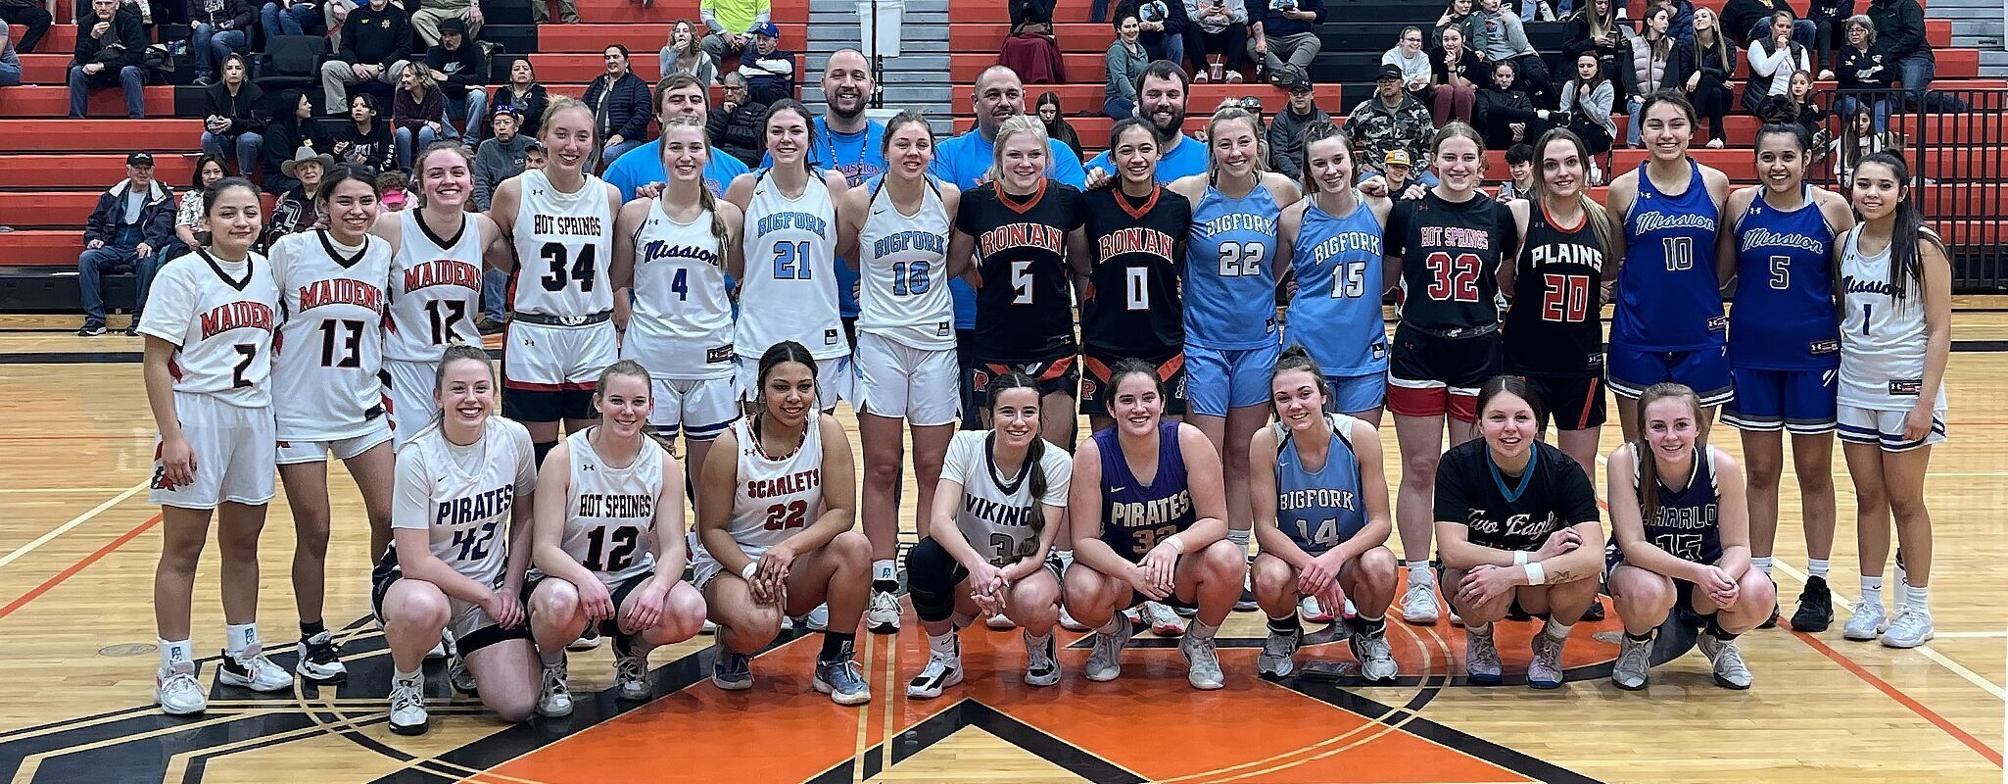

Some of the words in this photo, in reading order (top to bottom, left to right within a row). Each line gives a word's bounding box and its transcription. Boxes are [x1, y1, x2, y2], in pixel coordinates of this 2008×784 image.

[534, 214, 555, 236] HOT
[557, 215, 601, 237] SPRINGS
[757, 212, 827, 241] BIGFORK
[980, 222, 1063, 259] RONAN
[1206, 212, 1274, 239] BIGFORK
[1421, 226, 1443, 247] HOT
[1444, 227, 1489, 250] SPRINGS
[1636, 211, 1715, 236] Mission
[643, 239, 720, 266] Mission
[874, 230, 945, 259] BIGFORK
[1099, 226, 1175, 265] RONAN
[1314, 231, 1381, 265] BIGFORK
[1531, 243, 1603, 273] PLAINS
[1663, 237, 1694, 271] 10
[1741, 228, 1824, 255] Mission
[540, 242, 596, 293] 34
[773, 241, 812, 280] 21
[1218, 241, 1265, 277] 22
[1770, 256, 1791, 290] 5
[404, 259, 483, 296] MAIDENS
[671, 268, 688, 302] 4
[1011, 260, 1035, 305] 5
[1126, 266, 1150, 310] 0
[1331, 261, 1367, 299] 15
[1426, 251, 1483, 303] 32
[300, 278, 383, 317] MAIDENS
[1543, 273, 1590, 323] 20
[1862, 303, 1872, 336] 1
[319, 318, 365, 368] 13
[233, 344, 257, 389] 2
[748, 468, 820, 499] SCARLETS
[1279, 488, 1354, 512] BIGFORK
[436, 484, 513, 525] PIRATES
[579, 494, 602, 518] HOT
[605, 494, 651, 518] SPRINGS
[763, 500, 809, 531] 22
[1111, 489, 1190, 527] PIRATES
[1468, 507, 1500, 534] Two
[452, 521, 499, 562] 42
[583, 525, 640, 572] 12
[1296, 518, 1340, 548] 14
